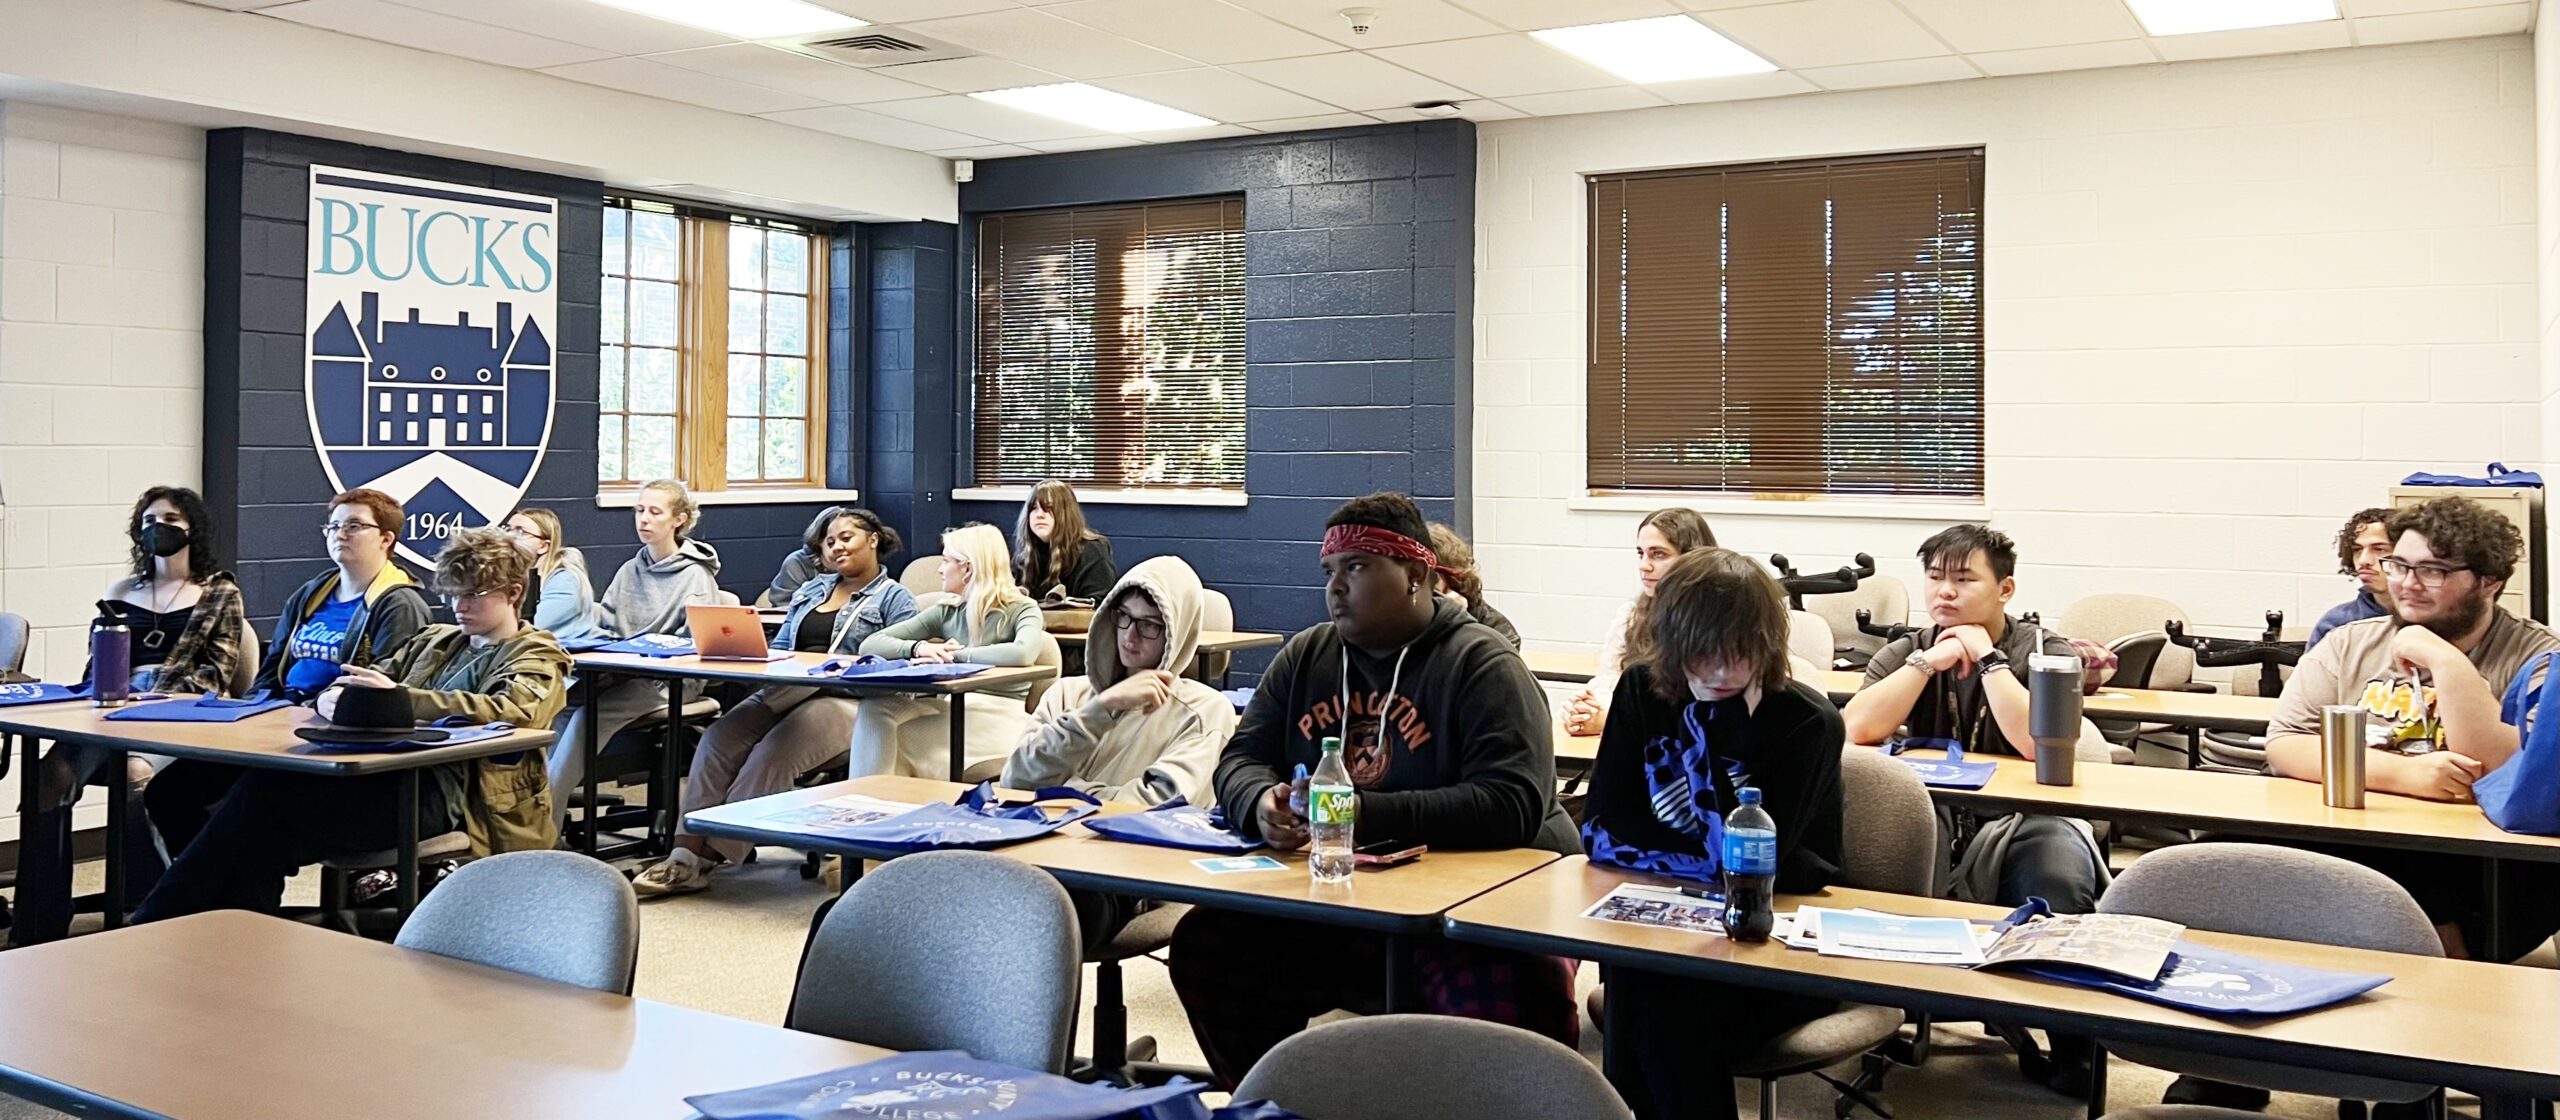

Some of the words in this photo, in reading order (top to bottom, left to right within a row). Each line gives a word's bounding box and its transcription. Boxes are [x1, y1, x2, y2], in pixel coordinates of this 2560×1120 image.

[313, 197, 552, 293] BUCKS
[406, 511, 464, 540] 1964
[1298, 690, 1432, 754] PRINCETON
